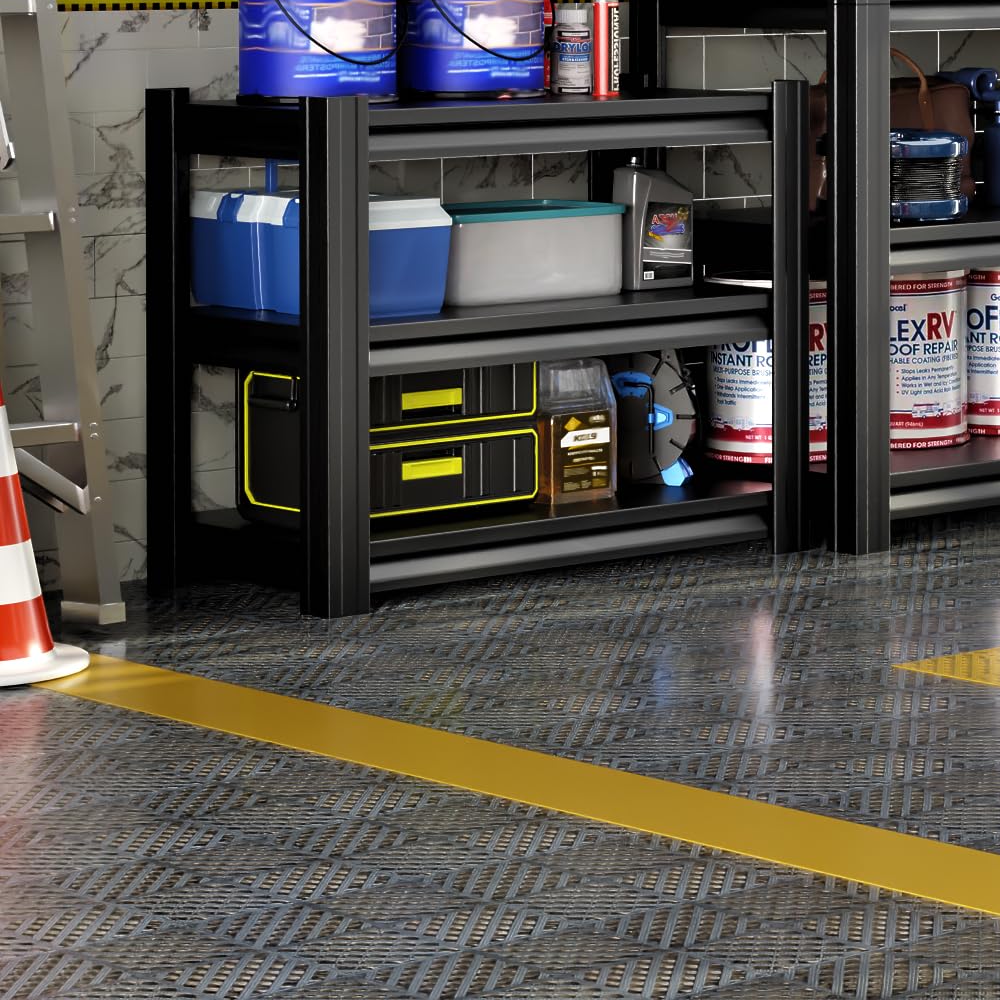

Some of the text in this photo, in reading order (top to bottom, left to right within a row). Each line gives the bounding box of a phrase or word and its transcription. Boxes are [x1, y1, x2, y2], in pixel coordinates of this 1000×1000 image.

[890, 304, 906, 312] ocel
[890, 343, 920, 356] OOF
[924, 339, 958, 355] REPAIR
[711, 353, 827, 368] INSTANT RO REP
